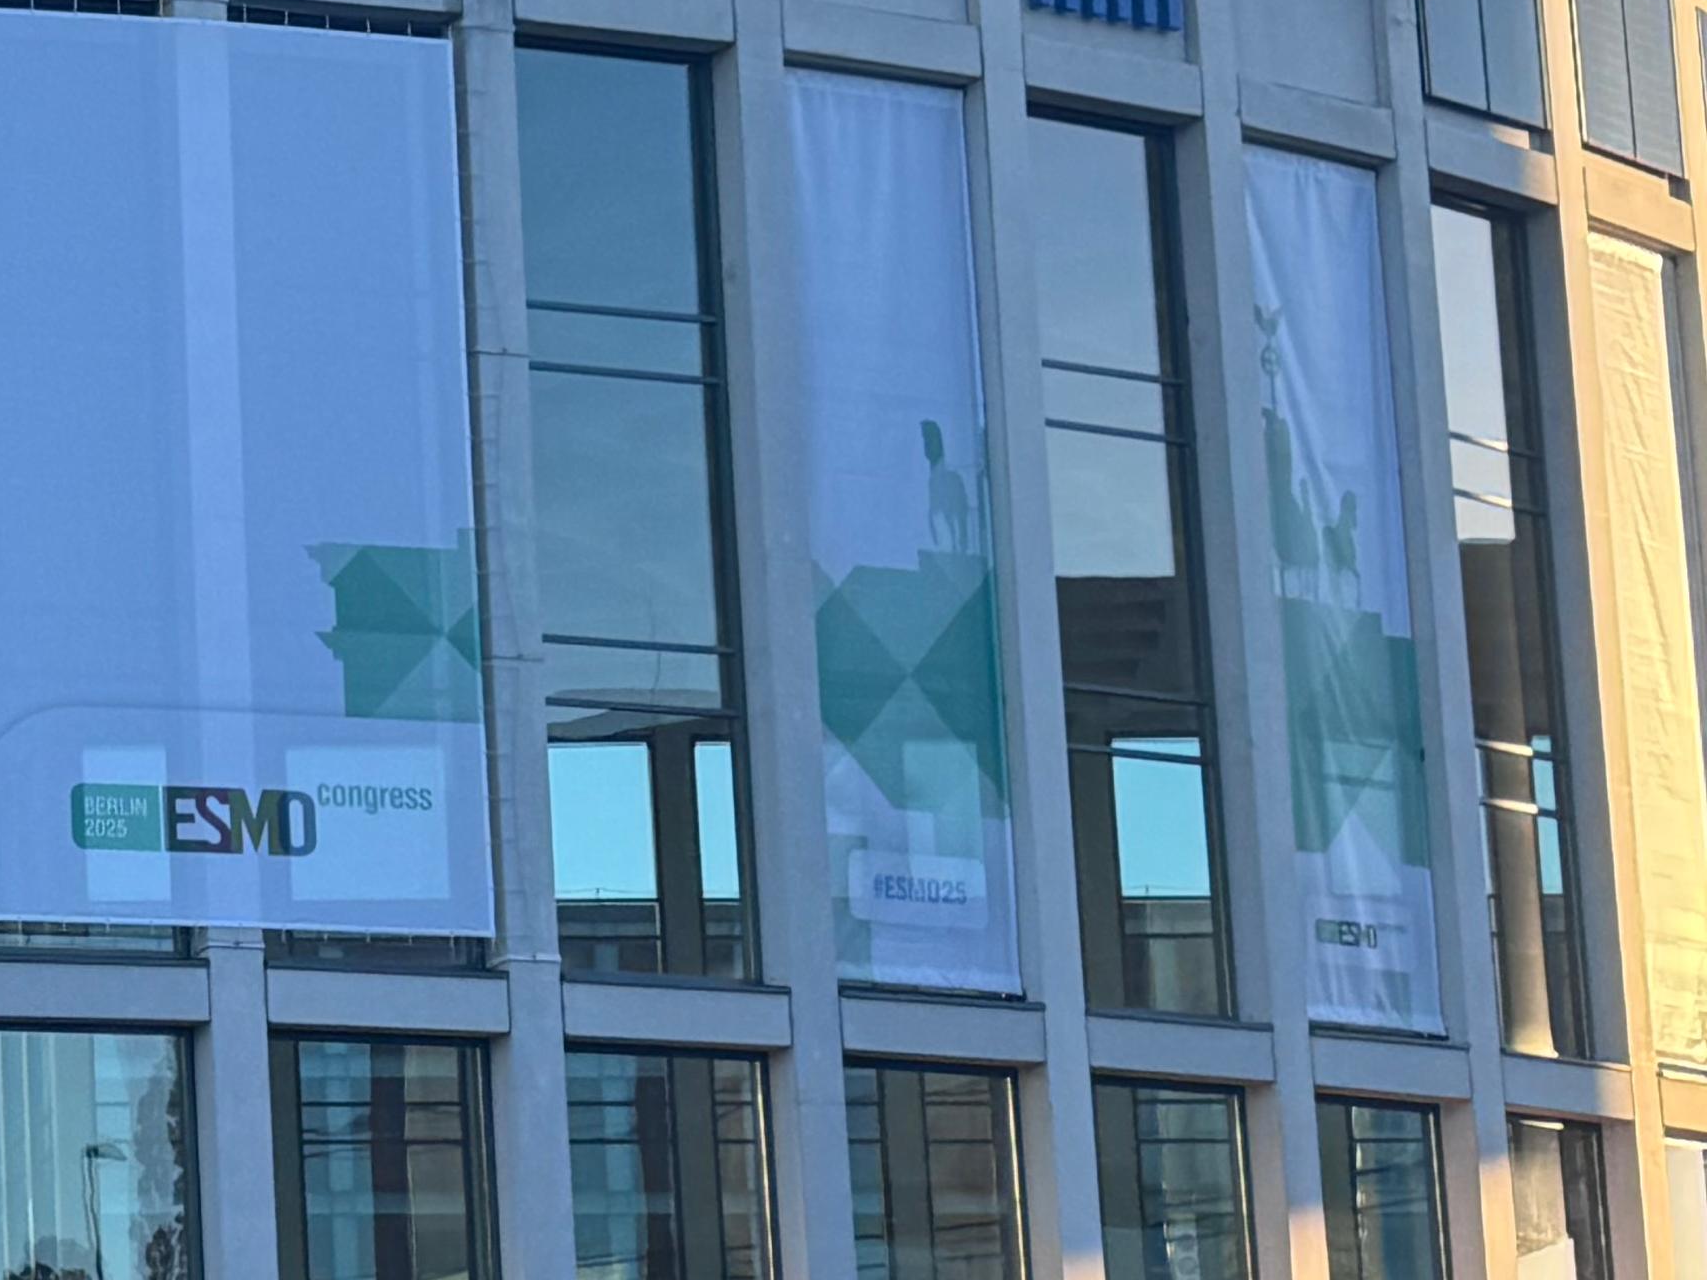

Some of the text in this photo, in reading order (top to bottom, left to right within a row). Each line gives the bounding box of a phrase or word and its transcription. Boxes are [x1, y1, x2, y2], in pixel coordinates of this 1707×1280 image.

[84, 795, 148, 819] BERLIN
[163, 782, 433, 857] ESMO congress
[84, 819, 128, 838] 2025
[1337, 920, 1378, 949] ESO
